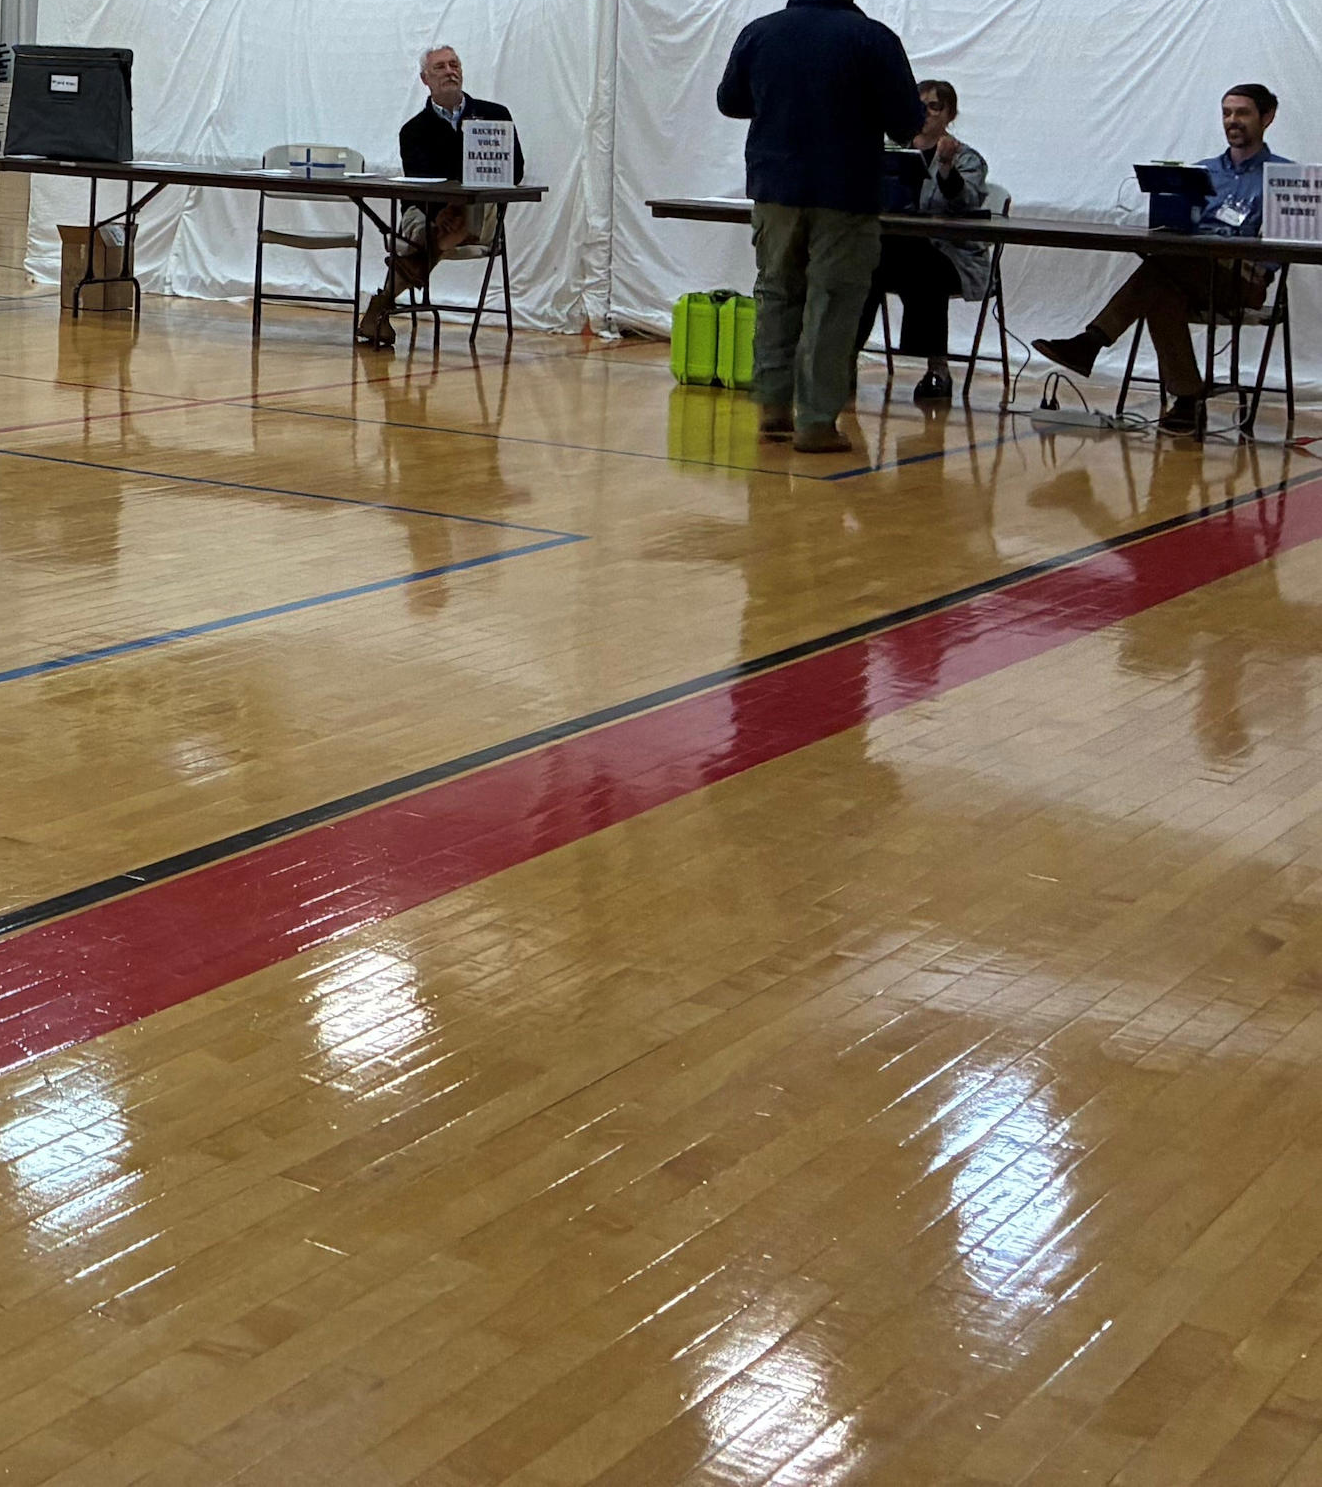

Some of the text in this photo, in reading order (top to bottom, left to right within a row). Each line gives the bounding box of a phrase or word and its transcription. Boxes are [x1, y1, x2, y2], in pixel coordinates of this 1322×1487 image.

[468, 151, 510, 161] BALLOT
[1269, 178, 1310, 188] CHECK
[1276, 194, 1321, 203] TO VOTE
